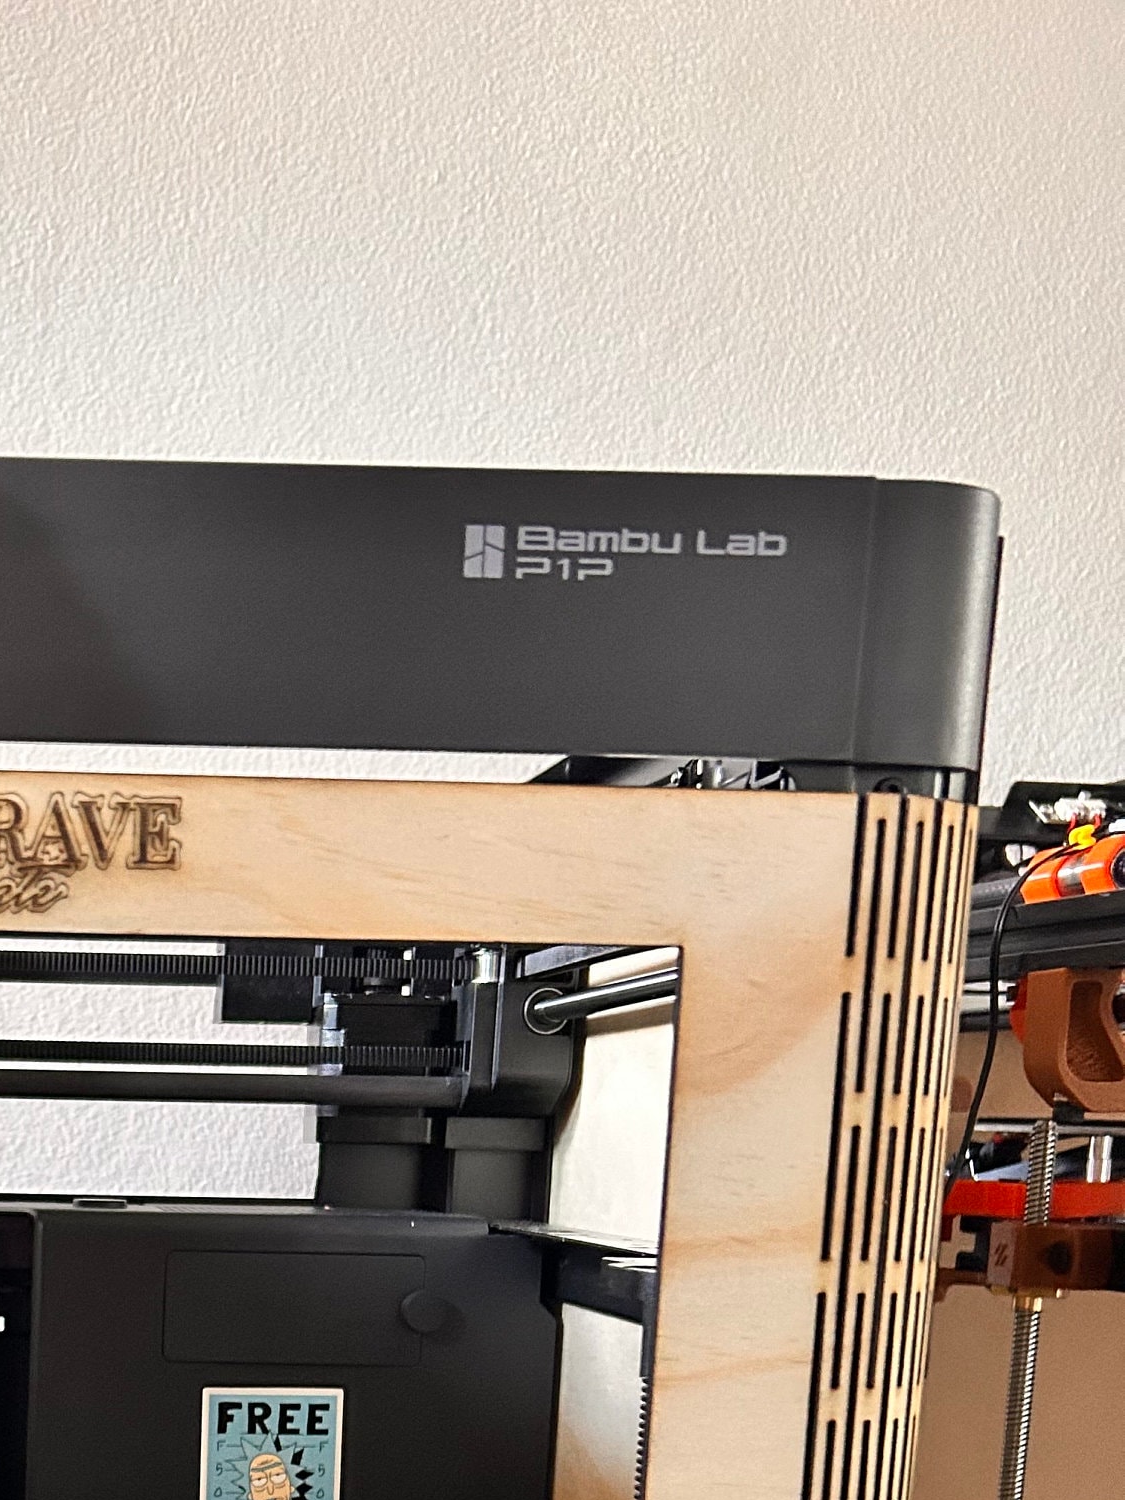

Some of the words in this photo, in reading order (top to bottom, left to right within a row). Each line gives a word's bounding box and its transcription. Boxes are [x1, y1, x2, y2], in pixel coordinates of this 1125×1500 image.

[517, 526, 682, 554] Bambu
[696, 530, 787, 557] Lab
[515, 556, 614, 581] P1P
[217, 1402, 330, 1435] FREE
